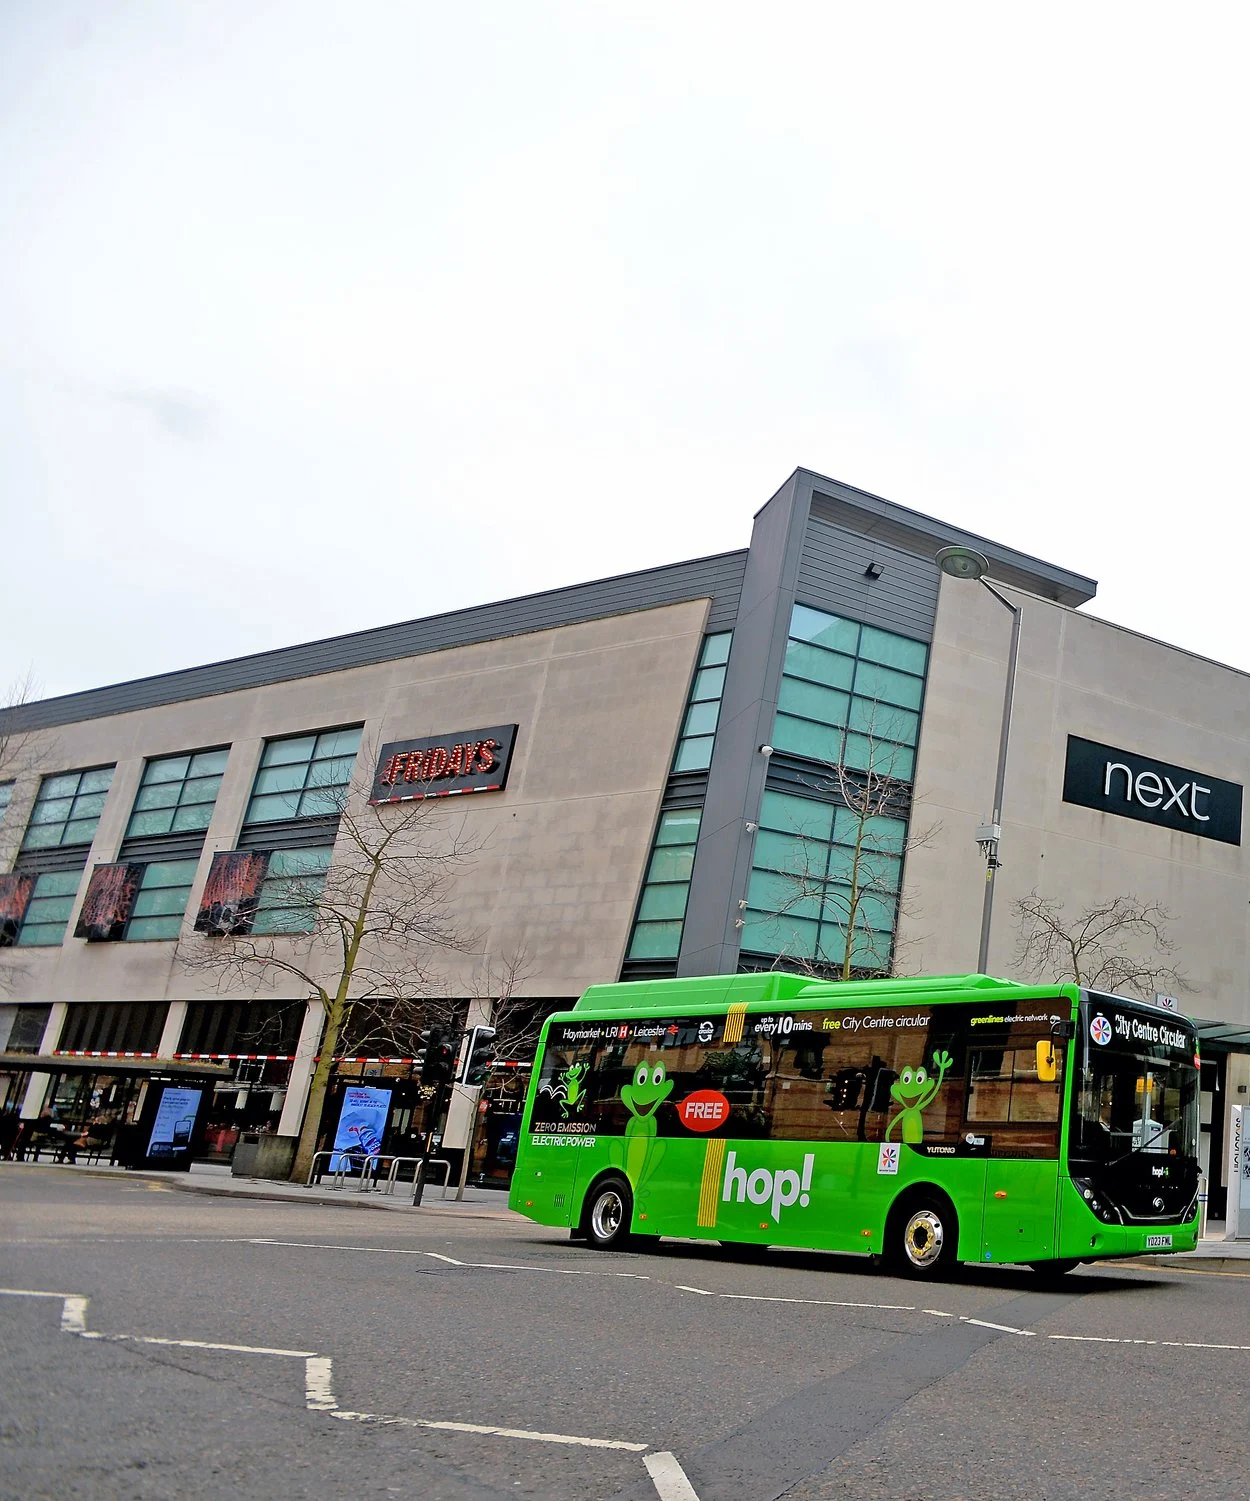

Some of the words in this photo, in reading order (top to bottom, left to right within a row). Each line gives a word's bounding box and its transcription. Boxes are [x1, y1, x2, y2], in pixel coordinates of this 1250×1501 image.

[1104, 761, 1211, 821] next
[754, 1022, 778, 1035] every
[777, 1016, 793, 1034] 10
[792, 1019, 813, 1031] mins
[822, 1018, 841, 1030] free
[842, 1016, 862, 1032] City
[862, 1016, 894, 1028] Centre
[895, 1014, 931, 1027] circular
[970, 1014, 1003, 1026] greenlines
[1004, 1014, 1023, 1023] electric
[1024, 1013, 1048, 1022] network
[562, 1027, 601, 1042] Haymarket
[633, 1025, 667, 1037] Leicester
[1115, 1014, 1131, 1040] City
[1132, 1019, 1159, 1043] Centre
[1159, 1025, 1186, 1049] Circular
[684, 1102, 724, 1119] FREE
[534, 1122, 557, 1132] ZERO
[556, 1122, 597, 1133] EMISSION
[531, 1135, 565, 1147] ELECTRIC
[565, 1136, 596, 1148] POWER
[926, 1146, 956, 1154] YUTONG
[722, 1151, 815, 1224] hop!
